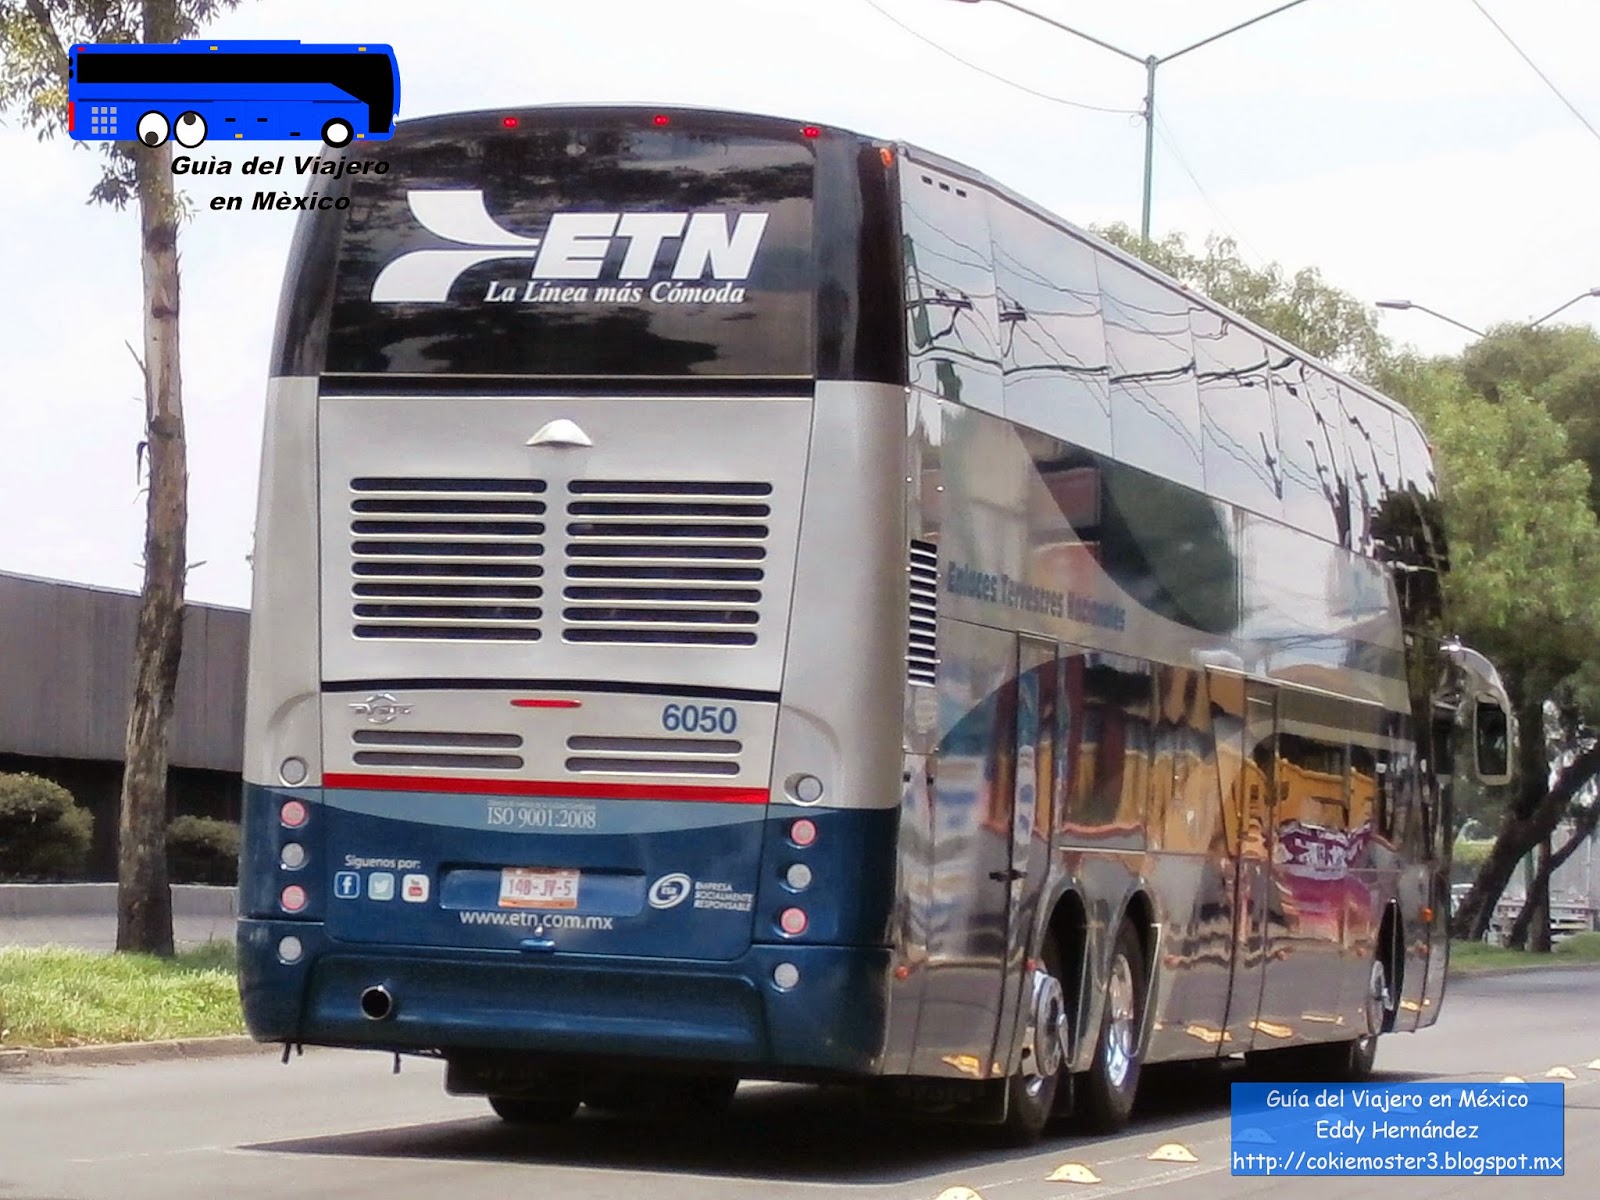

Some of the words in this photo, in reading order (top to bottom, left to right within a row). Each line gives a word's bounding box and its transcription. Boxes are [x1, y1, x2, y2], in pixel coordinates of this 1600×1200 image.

[531, 212, 769, 280] ETN
[483, 282, 516, 304] La
[522, 280, 587, 304] Línea
[594, 281, 643, 304] más
[649, 281, 746, 305] Cómoda
[662, 703, 738, 735] 6050
[487, 806, 515, 826] ISO
[518, 807, 597, 829] 9001:2008
[459, 911, 614, 930] www.etn.com.mx
